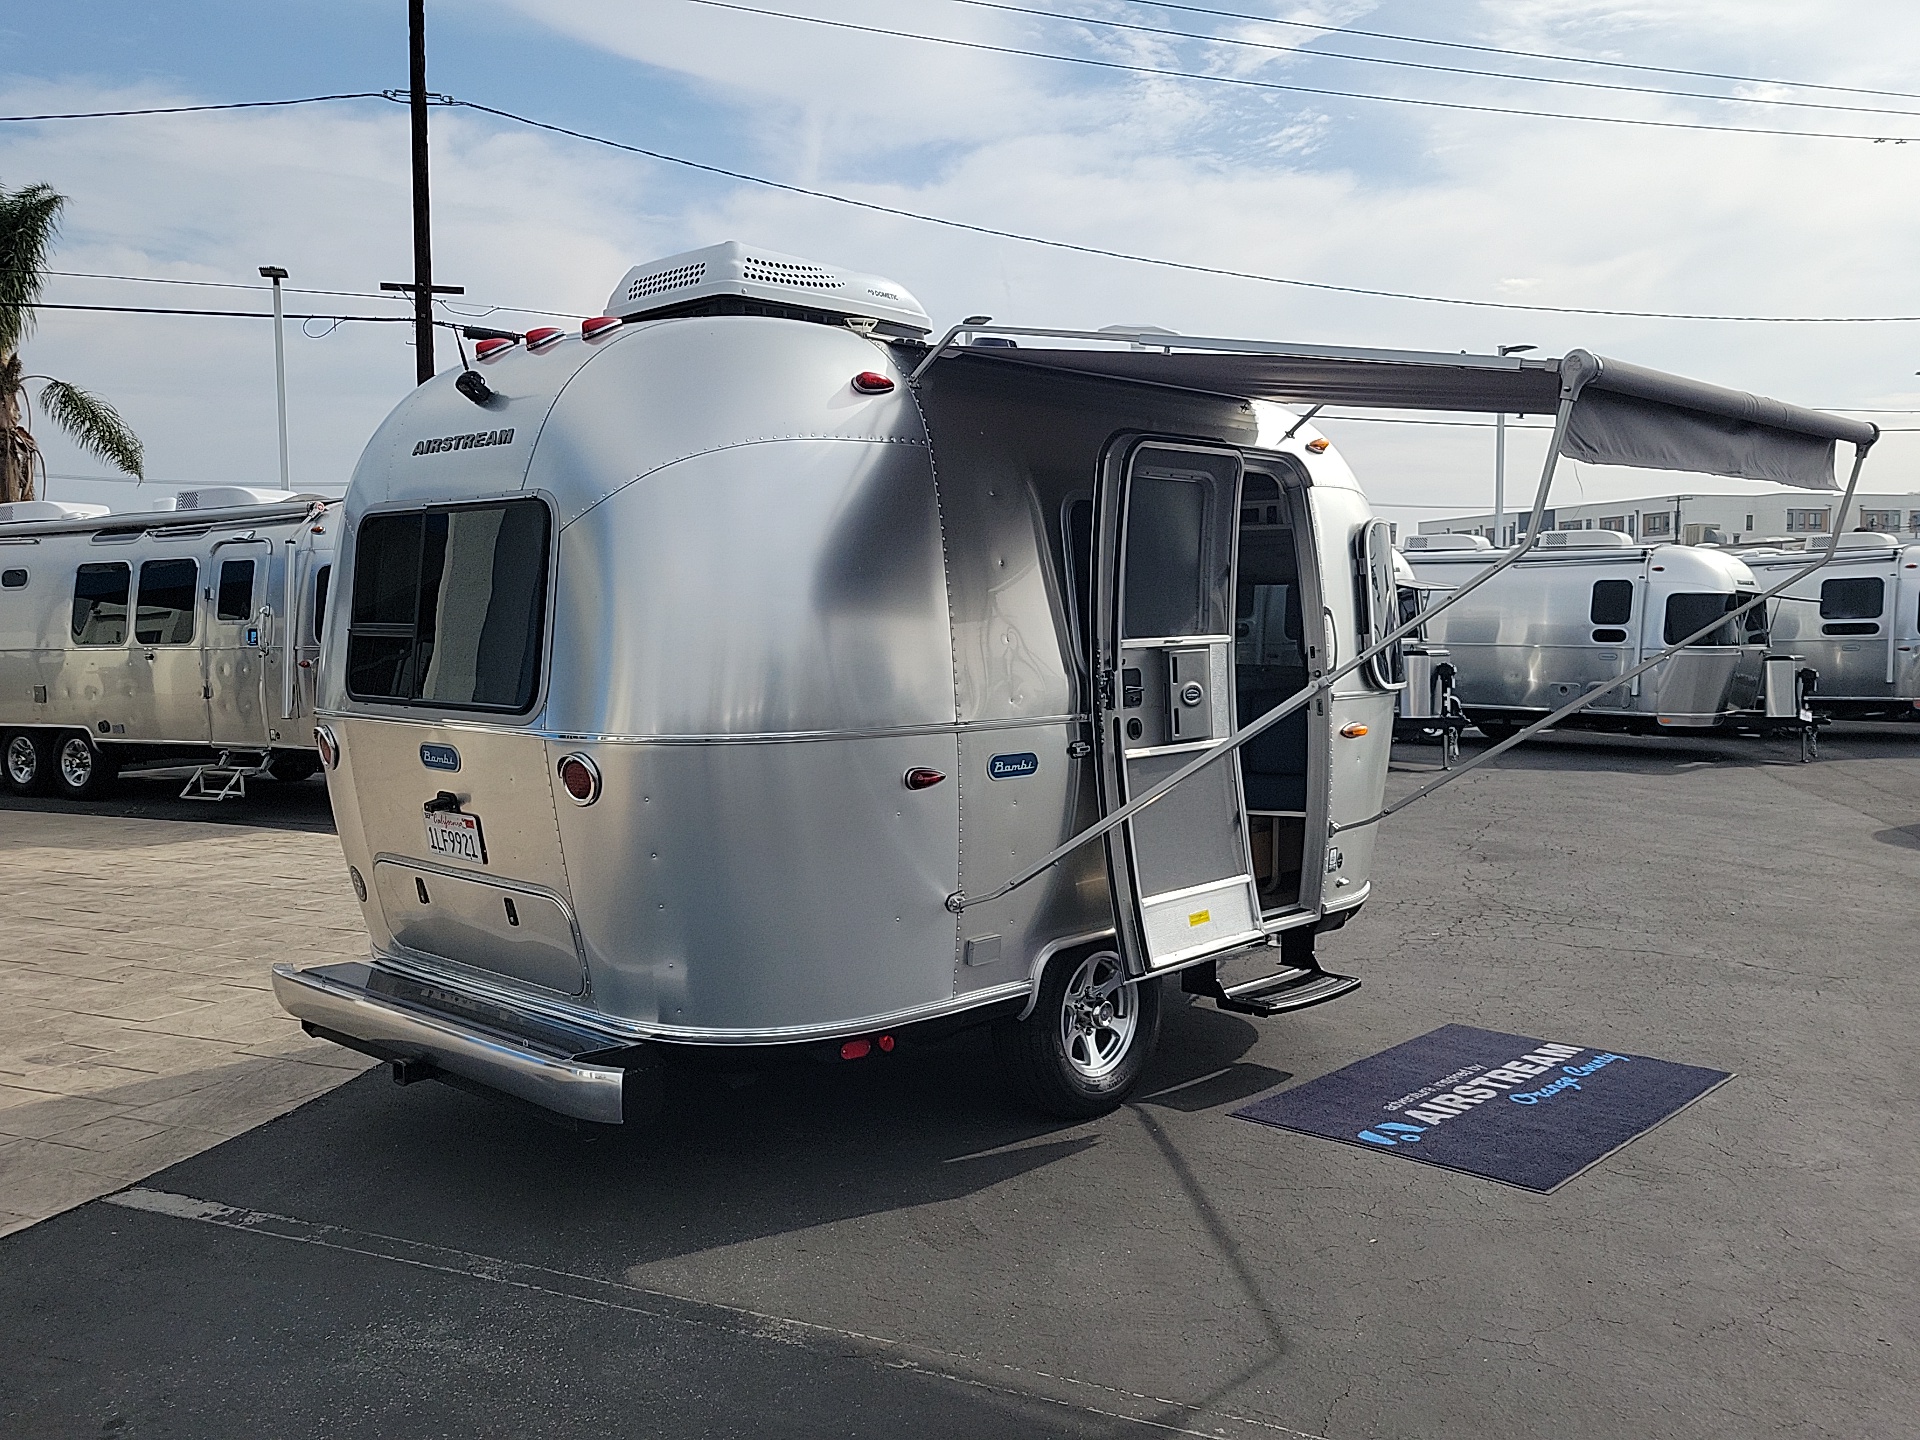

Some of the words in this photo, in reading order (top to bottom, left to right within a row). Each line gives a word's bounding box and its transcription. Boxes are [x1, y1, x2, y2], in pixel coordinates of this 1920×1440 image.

[412, 428, 515, 457] AIRSTREAM
[423, 750, 455, 765] Bambi
[994, 759, 1035, 773] Bambi
[433, 812, 463, 829] California
[428, 826, 478, 859] 1LF9921
[1404, 1042, 1586, 1126] AIRSTREAM
[1508, 1076, 1581, 1106] Orange
[1562, 1051, 1631, 1078] County
